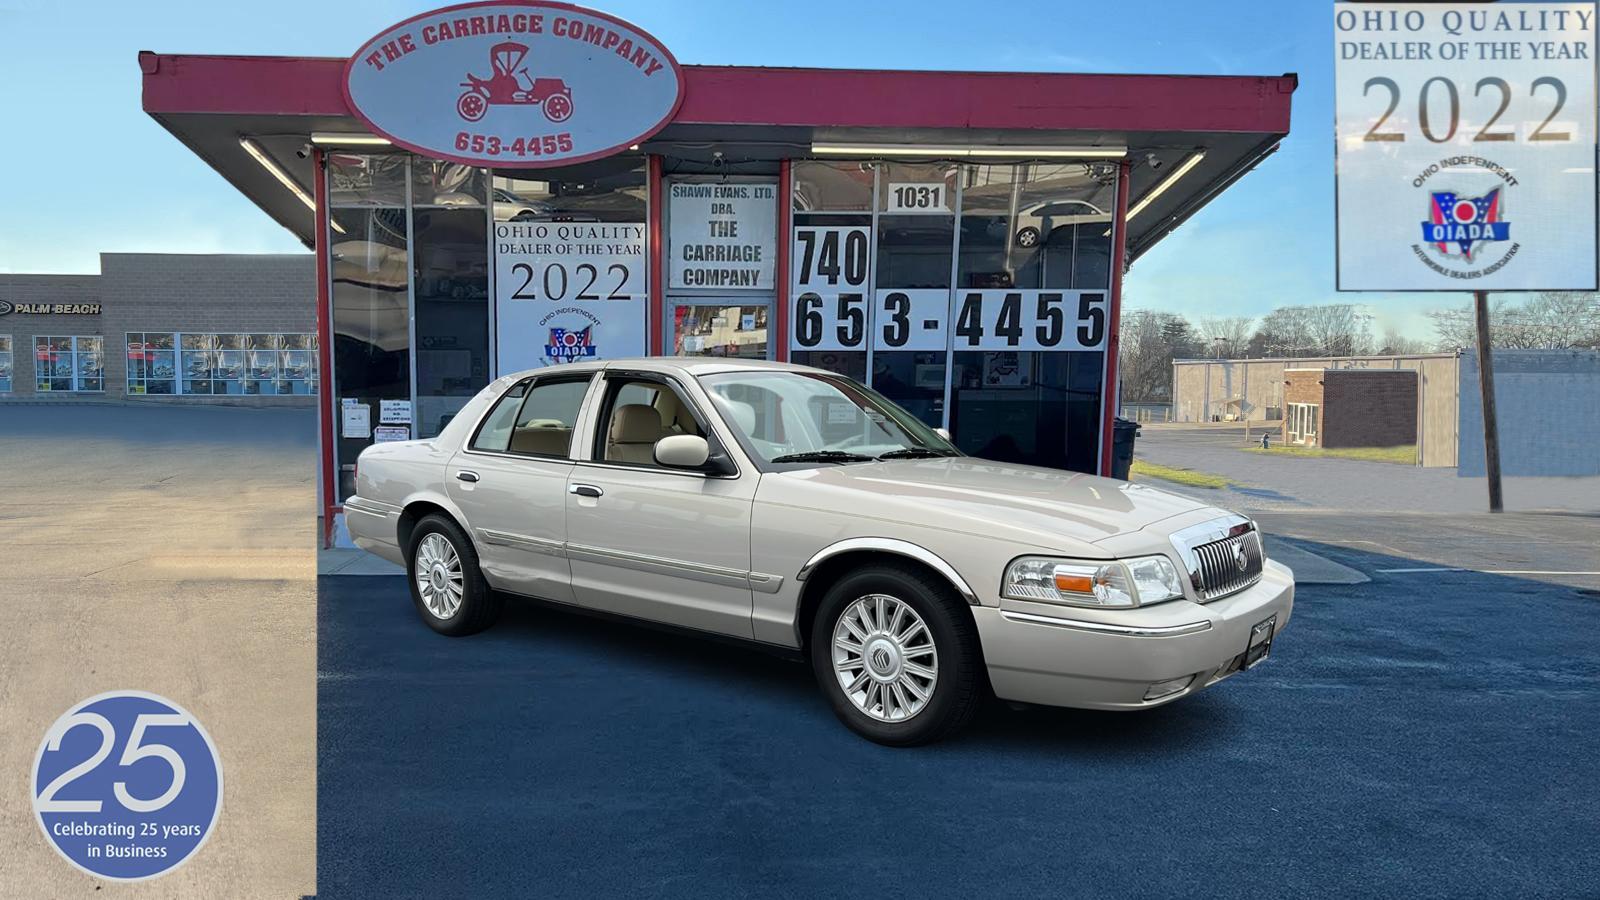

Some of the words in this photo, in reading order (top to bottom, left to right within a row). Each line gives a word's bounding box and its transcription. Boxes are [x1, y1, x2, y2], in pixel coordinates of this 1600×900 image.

[1336, 10, 1425, 31] OHIO
[1442, 10, 1593, 35] QUALITY
[366, 34, 417, 71] THE
[422, 14, 544, 46] CARRIAGE
[552, 17, 664, 77] COMPANY
[1340, 42, 1433, 60] DEALER
[1439, 42, 1469, 60] OF
[1475, 42, 1522, 60] THE
[1528, 42, 1589, 60] YEAR
[1363, 76, 1571, 143] 2022
[455, 132, 573, 156] 653-4455
[1413, 164, 1439, 188] OHIO
[1440, 156, 1519, 187] INDEPENDENT
[672, 186, 712, 198] SHAWN
[754, 187, 774, 199] LTD.
[894, 187, 940, 208] 1031
[711, 203, 735, 215] DBA.
[497, 226, 548, 239] OHIO
[558, 226, 644, 241] QUALITY
[709, 221, 737, 237] THE
[1433, 224, 1495, 240] OIADA
[500, 244, 551, 254] DEALER
[556, 244, 575, 254] OF
[577, 244, 605, 255] THE
[607, 244, 641, 255] YEAR
[683, 245, 762, 262] CARRIAGE
[797, 229, 868, 287] 740
[511, 263, 631, 300] 2022
[683, 269, 760, 286] COMPANY
[15, 304, 51, 313] PALM
[55, 304, 100, 314] BEACH
[555, 307, 601, 326] INDEPENDENT
[551, 346, 587, 356] OIADA
